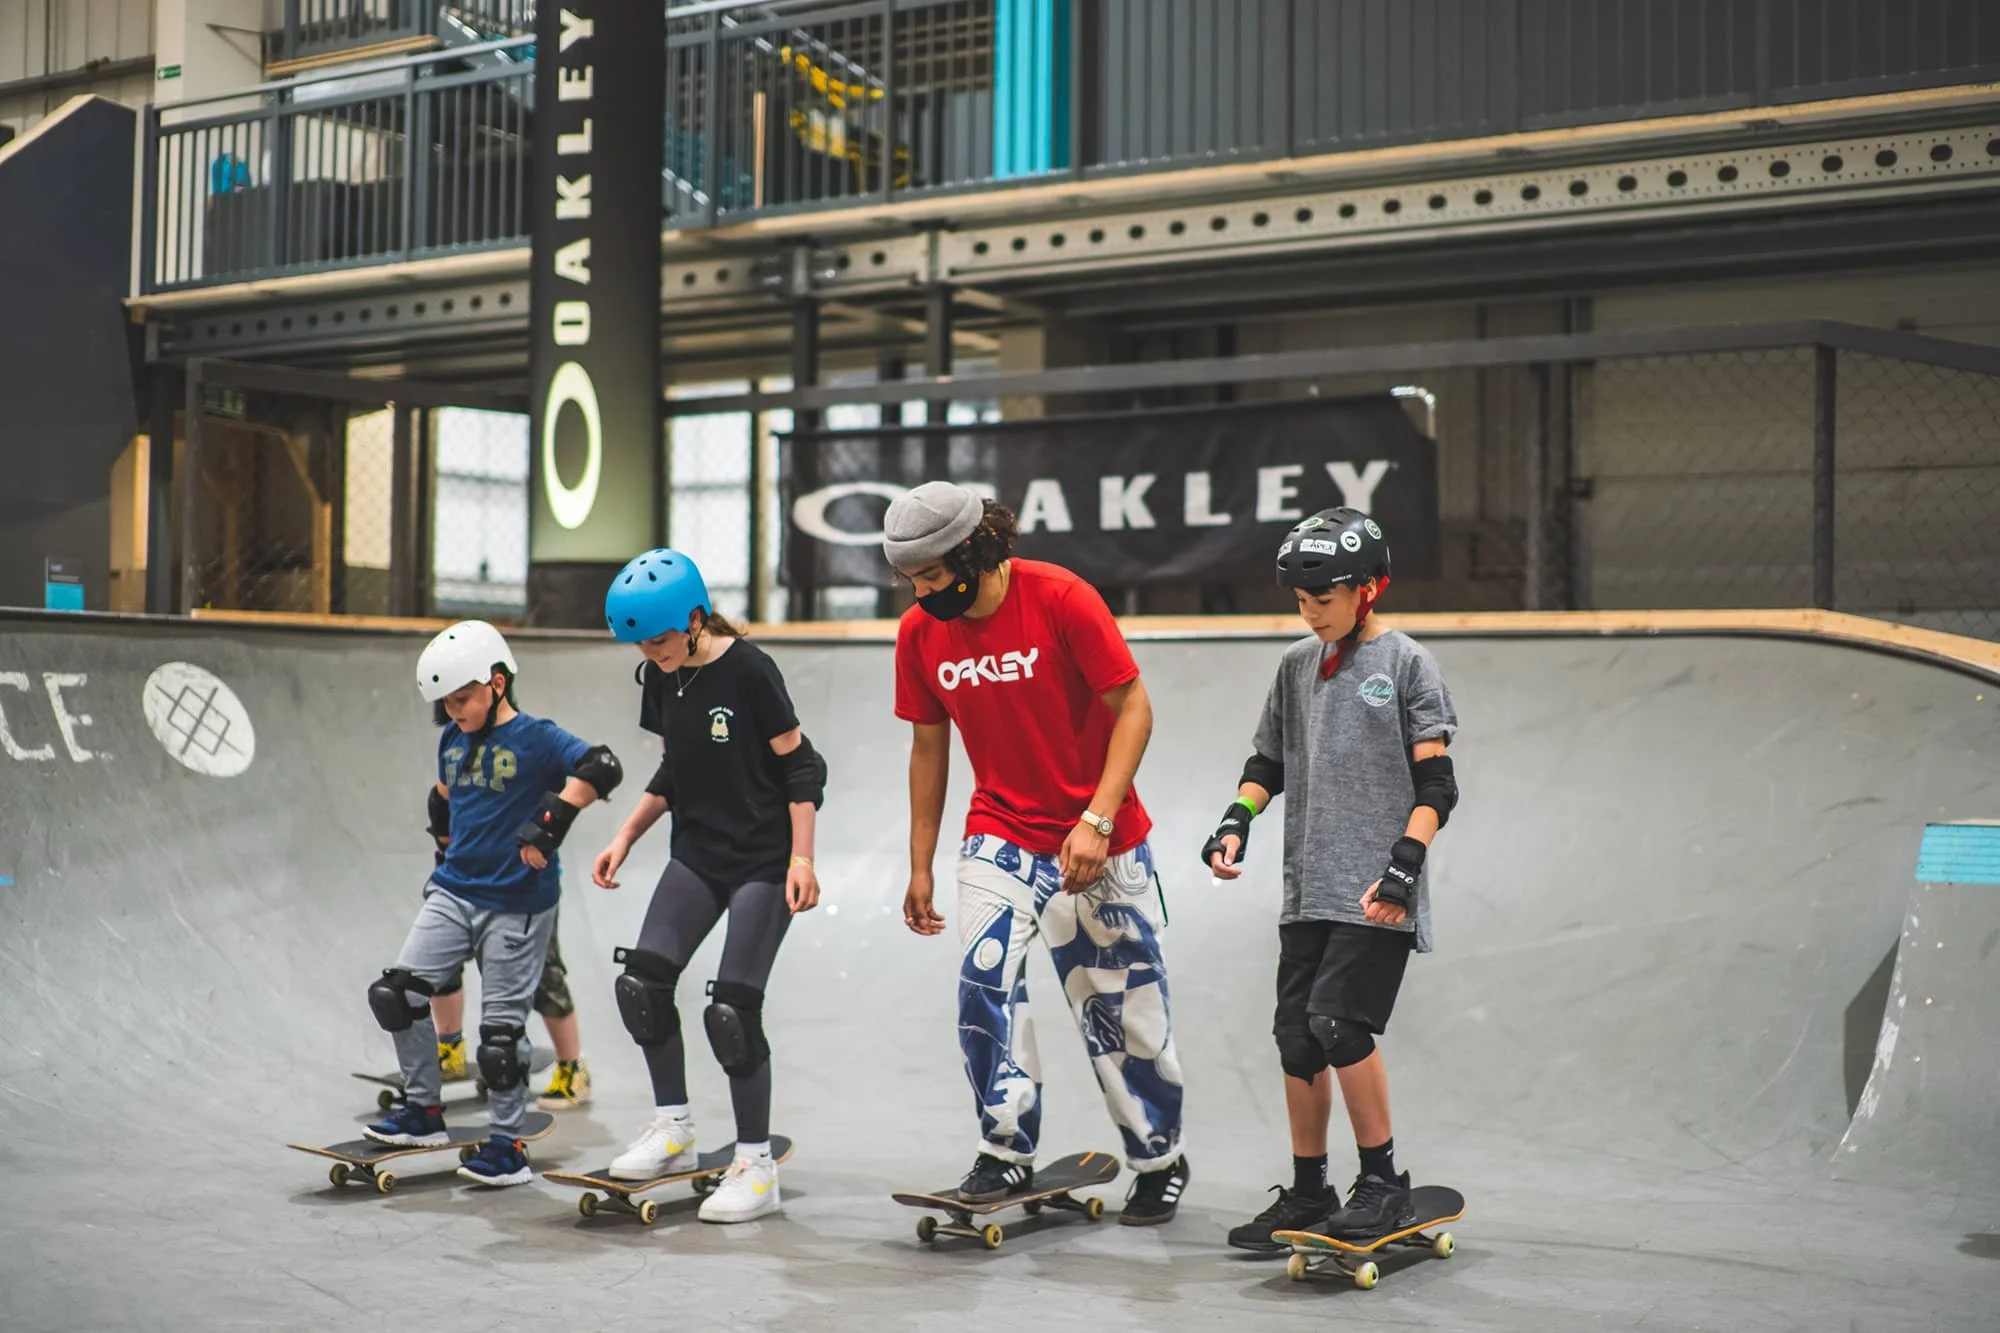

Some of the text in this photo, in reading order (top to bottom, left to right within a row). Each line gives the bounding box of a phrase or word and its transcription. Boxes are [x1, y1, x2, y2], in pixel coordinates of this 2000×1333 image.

[554, 8, 594, 346] OAKLEY
[957, 460, 1389, 533] AKLEY
[938, 648, 1039, 691] OAKLEY
